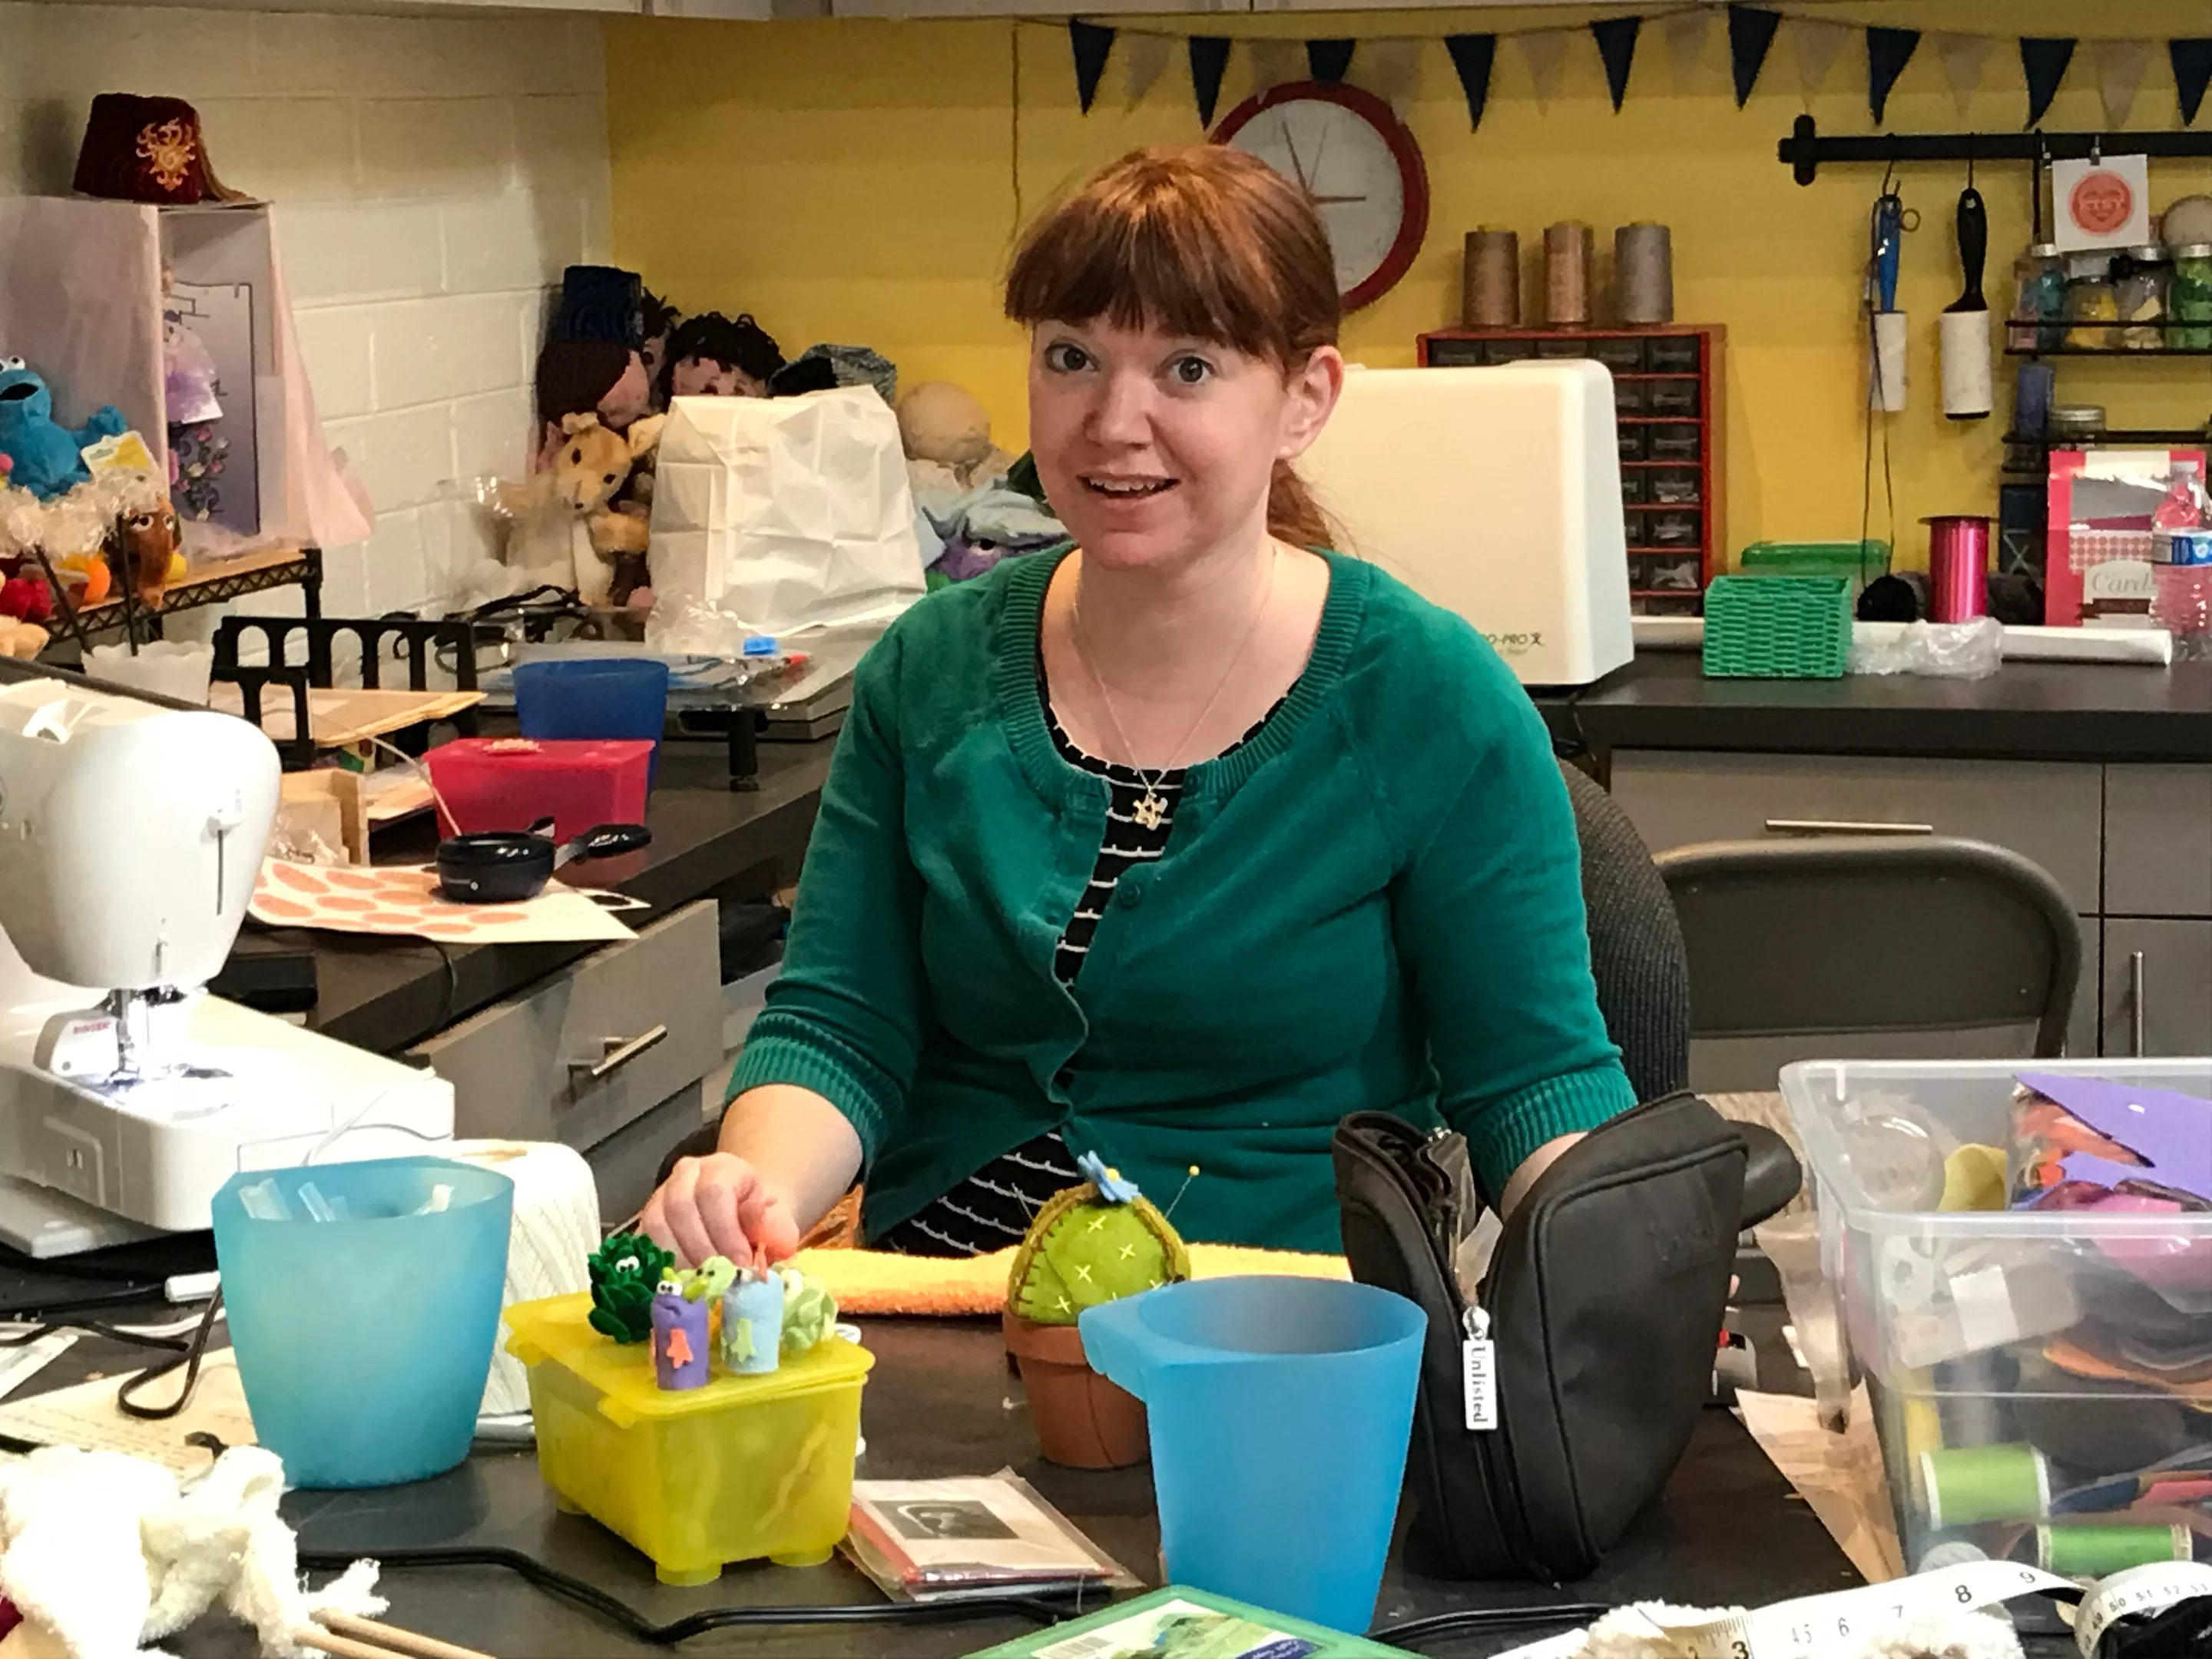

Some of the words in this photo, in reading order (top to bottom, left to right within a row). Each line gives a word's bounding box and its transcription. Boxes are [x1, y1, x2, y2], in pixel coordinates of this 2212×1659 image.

[1472, 1346, 1488, 1422] Unlisted
[1837, 1616, 1850, 1637] 6
[1890, 1604, 1904, 1619] 7
[1955, 1584, 1973, 1604] 8
[2018, 1571, 2036, 1584] 9
